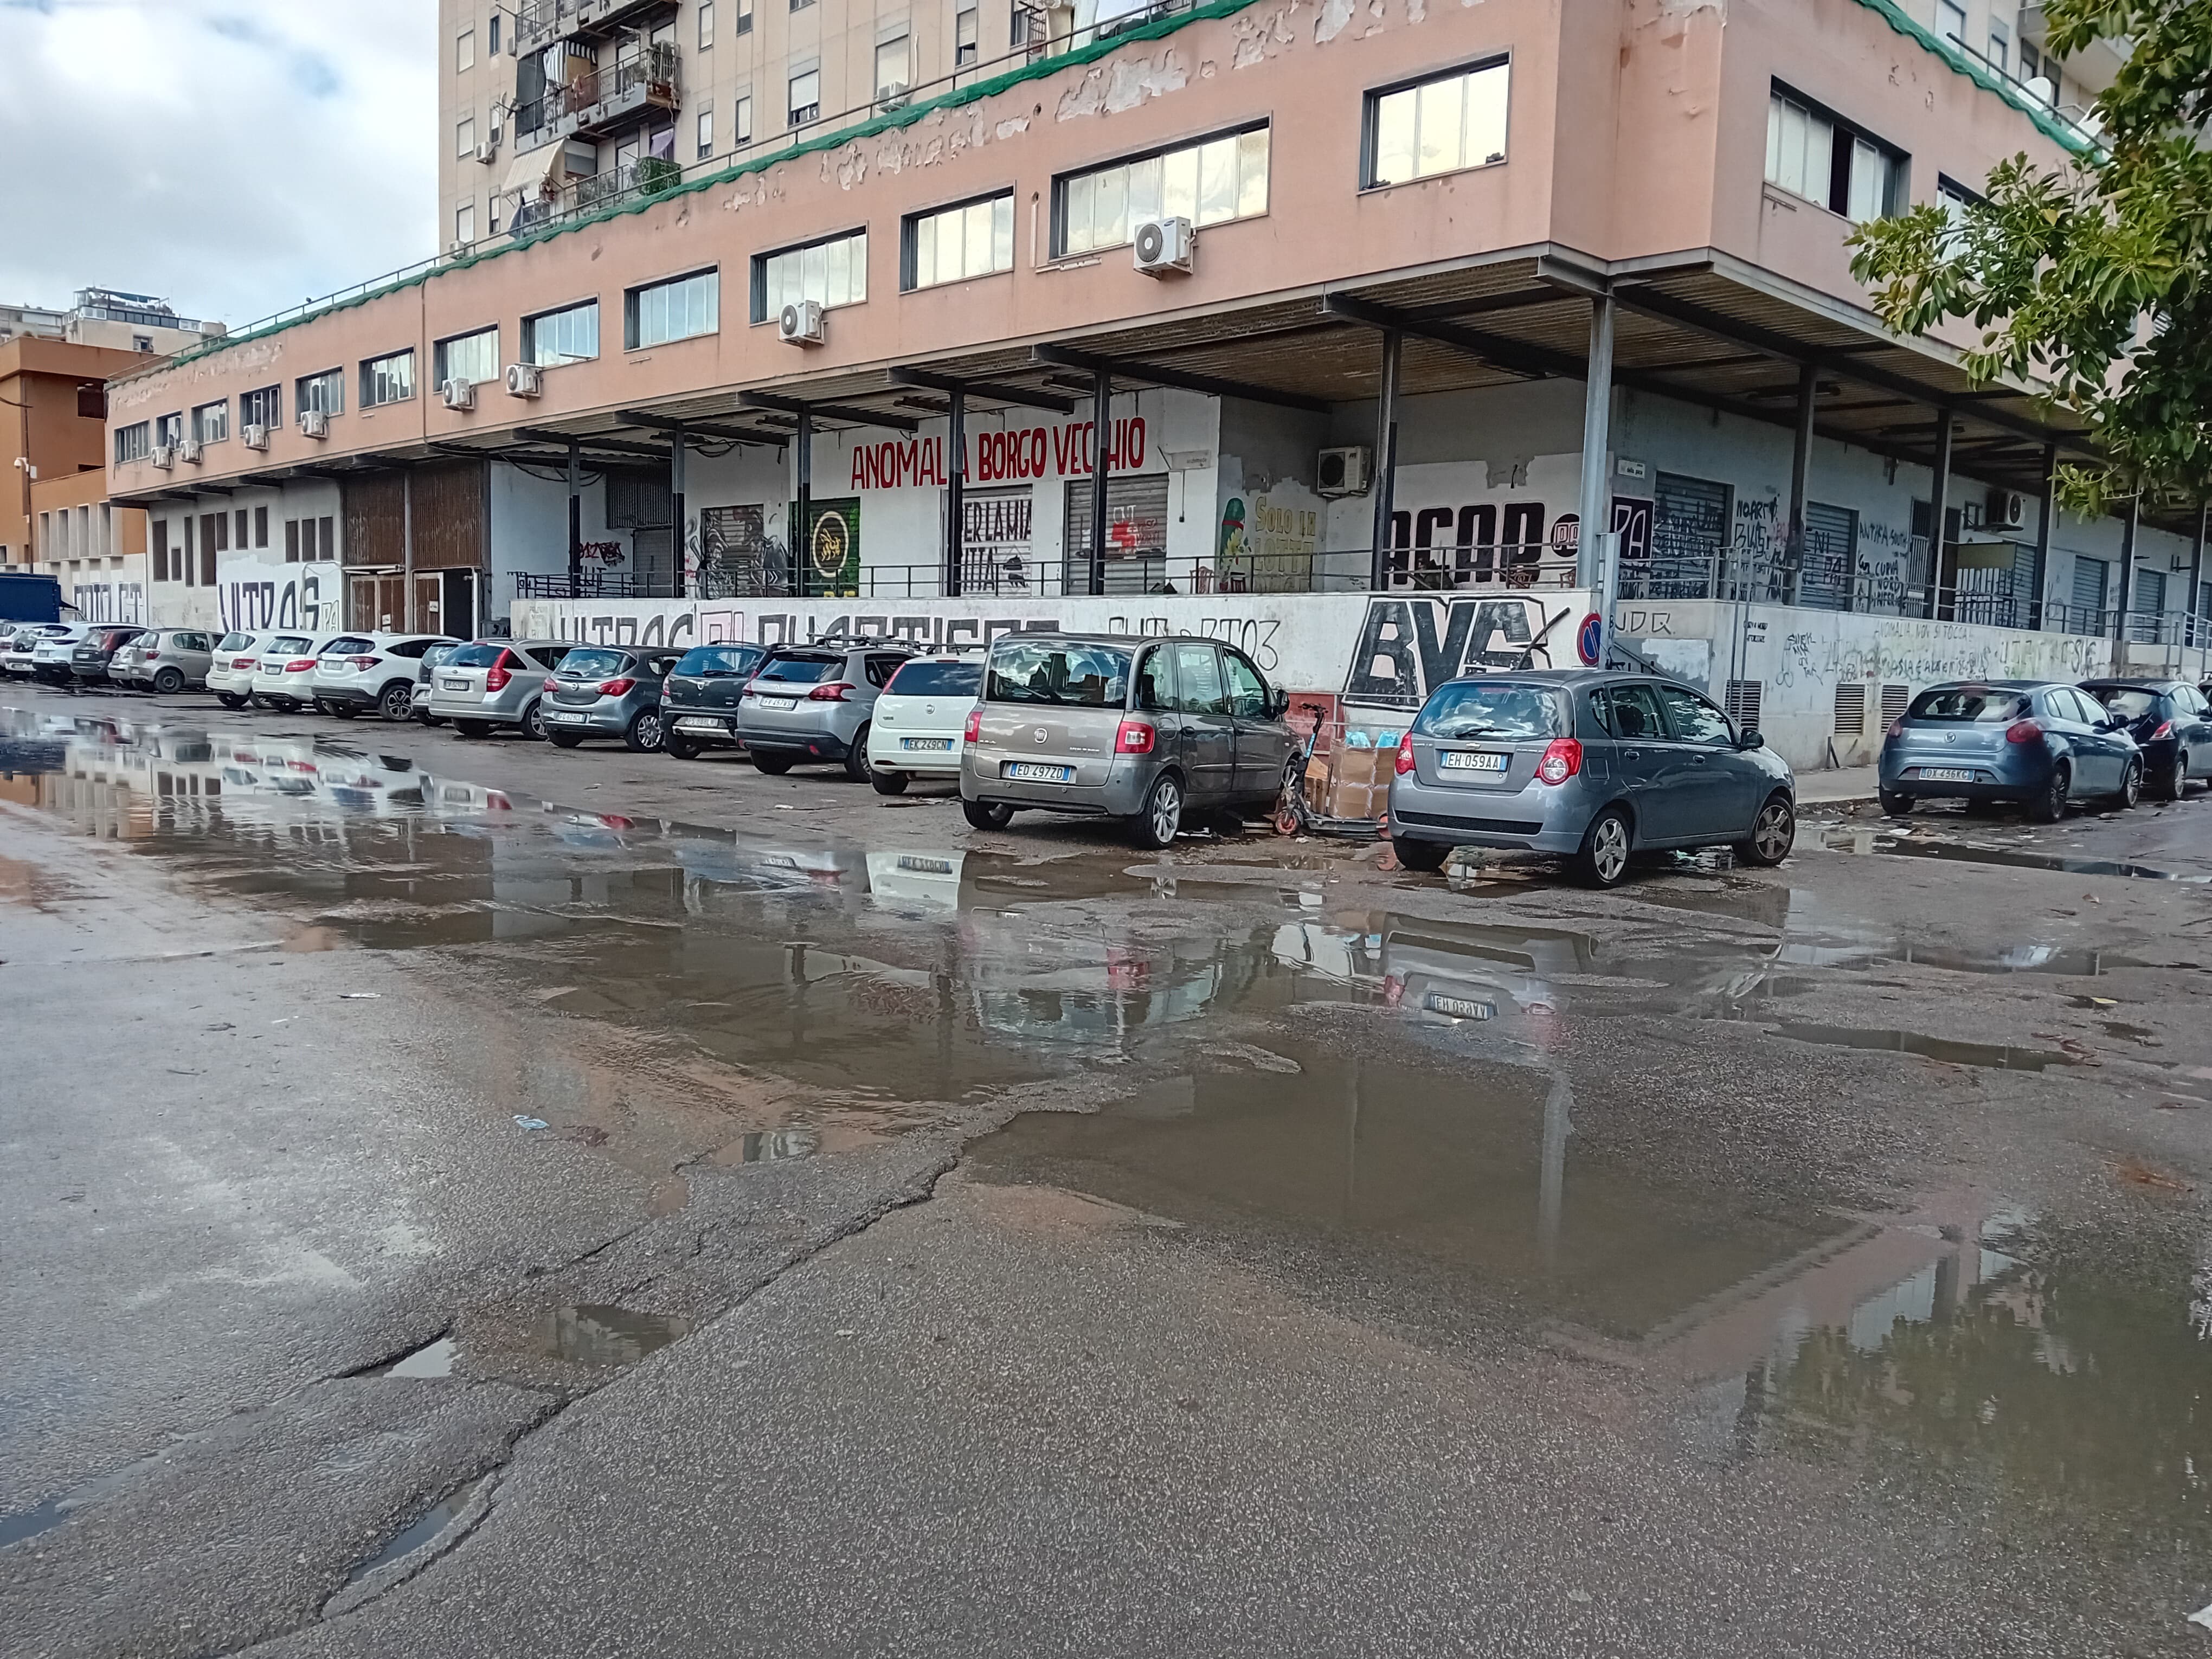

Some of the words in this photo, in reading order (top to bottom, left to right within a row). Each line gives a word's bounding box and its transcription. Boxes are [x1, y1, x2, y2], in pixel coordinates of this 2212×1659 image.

[978, 427, 1047, 481] BORGO
[1052, 416, 1146, 475] VECHIO
[909, 740, 919, 749] EK
[922, 740, 947, 750] 249CN
[1448, 754, 1462, 766] EH
[1465, 755, 1498, 769] 059AA
[1017, 764, 1030, 776] ED
[1032, 766, 1063, 779] 497ZD
[1927, 768, 1938, 777] DX
